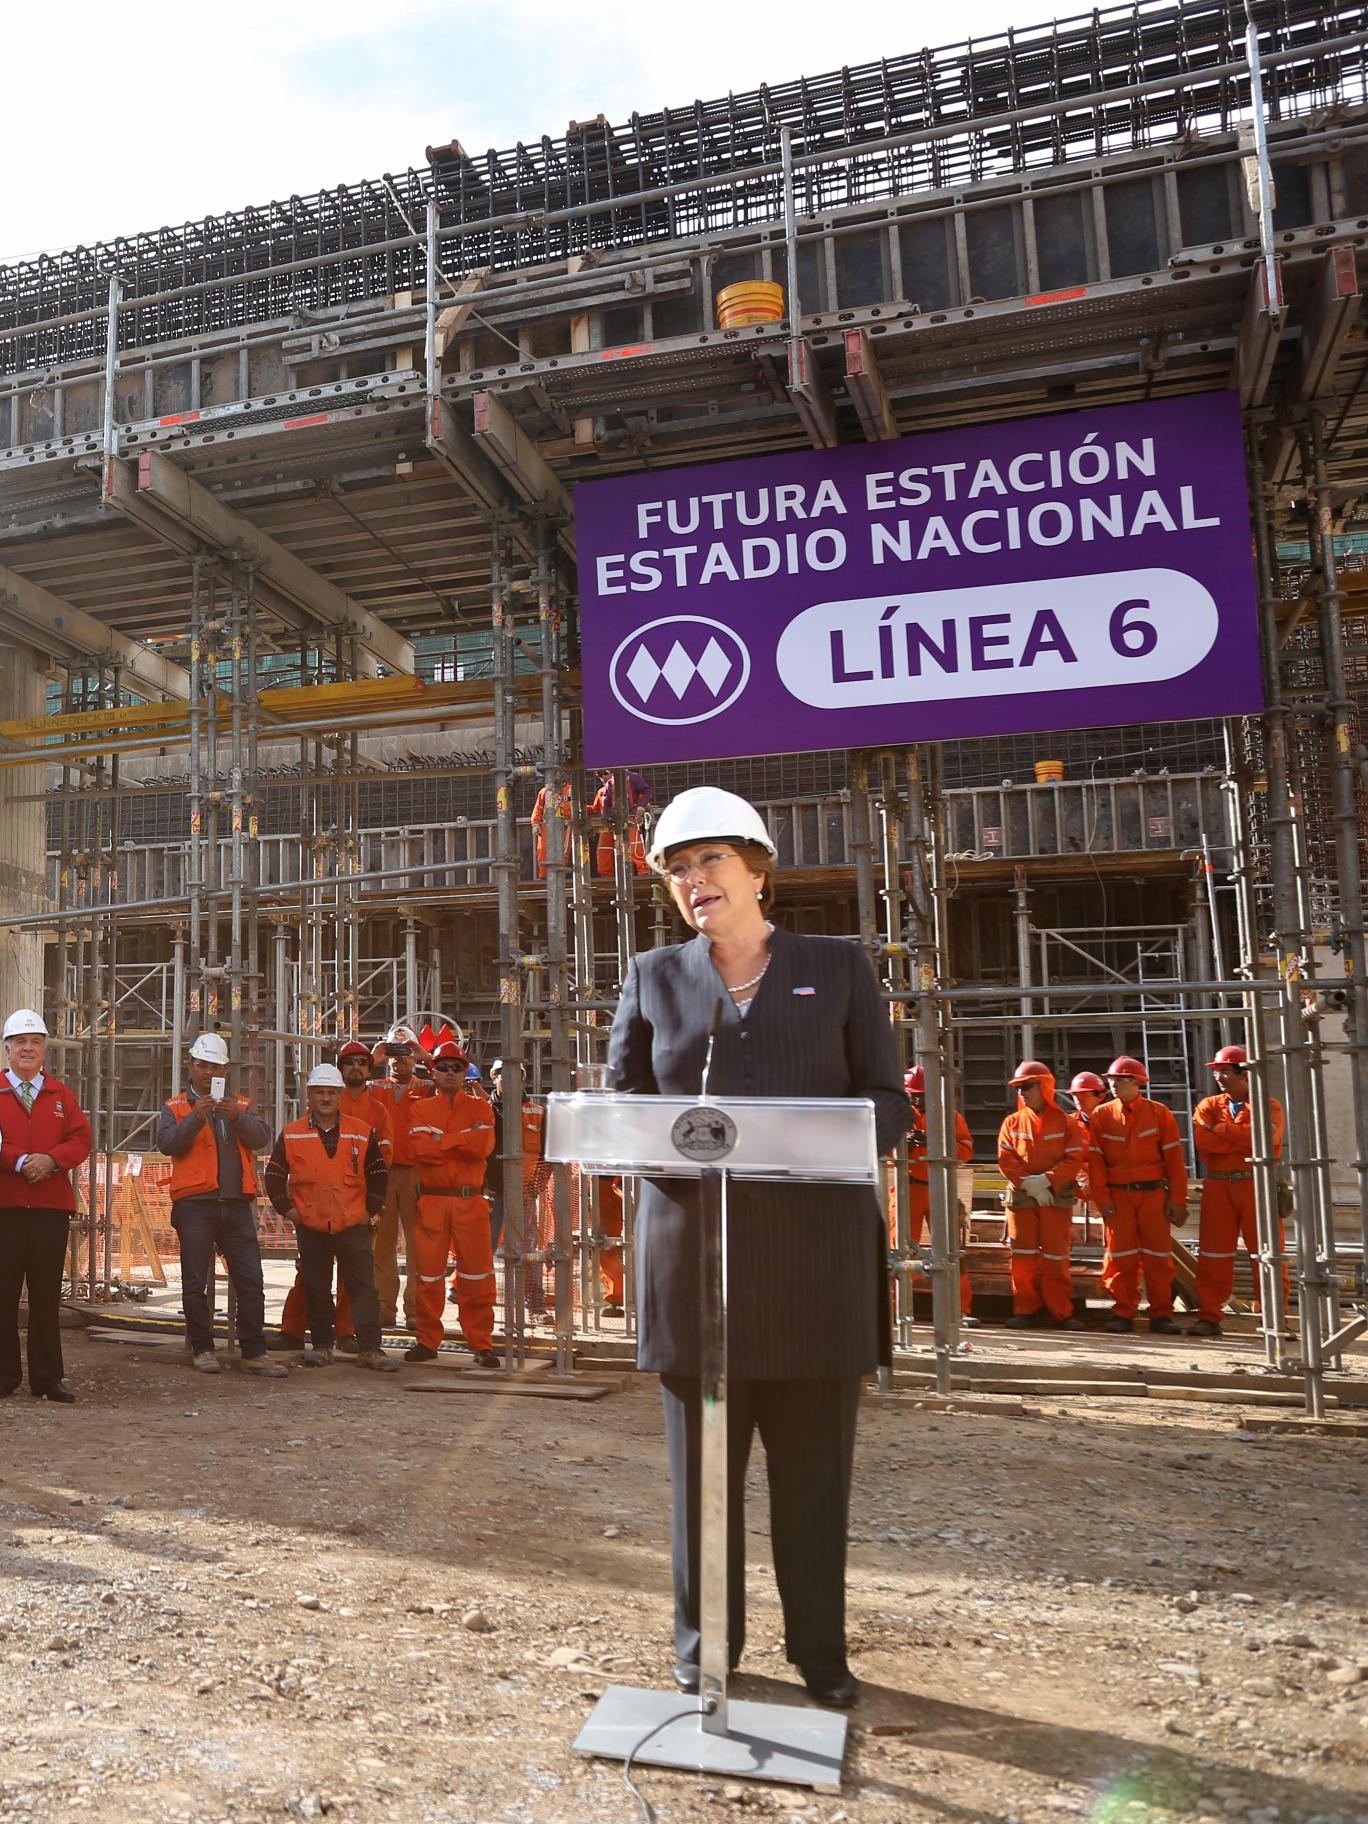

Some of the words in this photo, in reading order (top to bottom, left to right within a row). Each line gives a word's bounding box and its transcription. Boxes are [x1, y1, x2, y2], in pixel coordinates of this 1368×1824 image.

[637, 478, 848, 539] FUTURA
[865, 432, 1157, 511] ESTACIÓN
[595, 528, 848, 596] ESTADIO
[870, 485, 1221, 566] NACIONAL
[829, 605, 1079, 685] LÍNEA
[1109, 599, 1159, 659] 6
